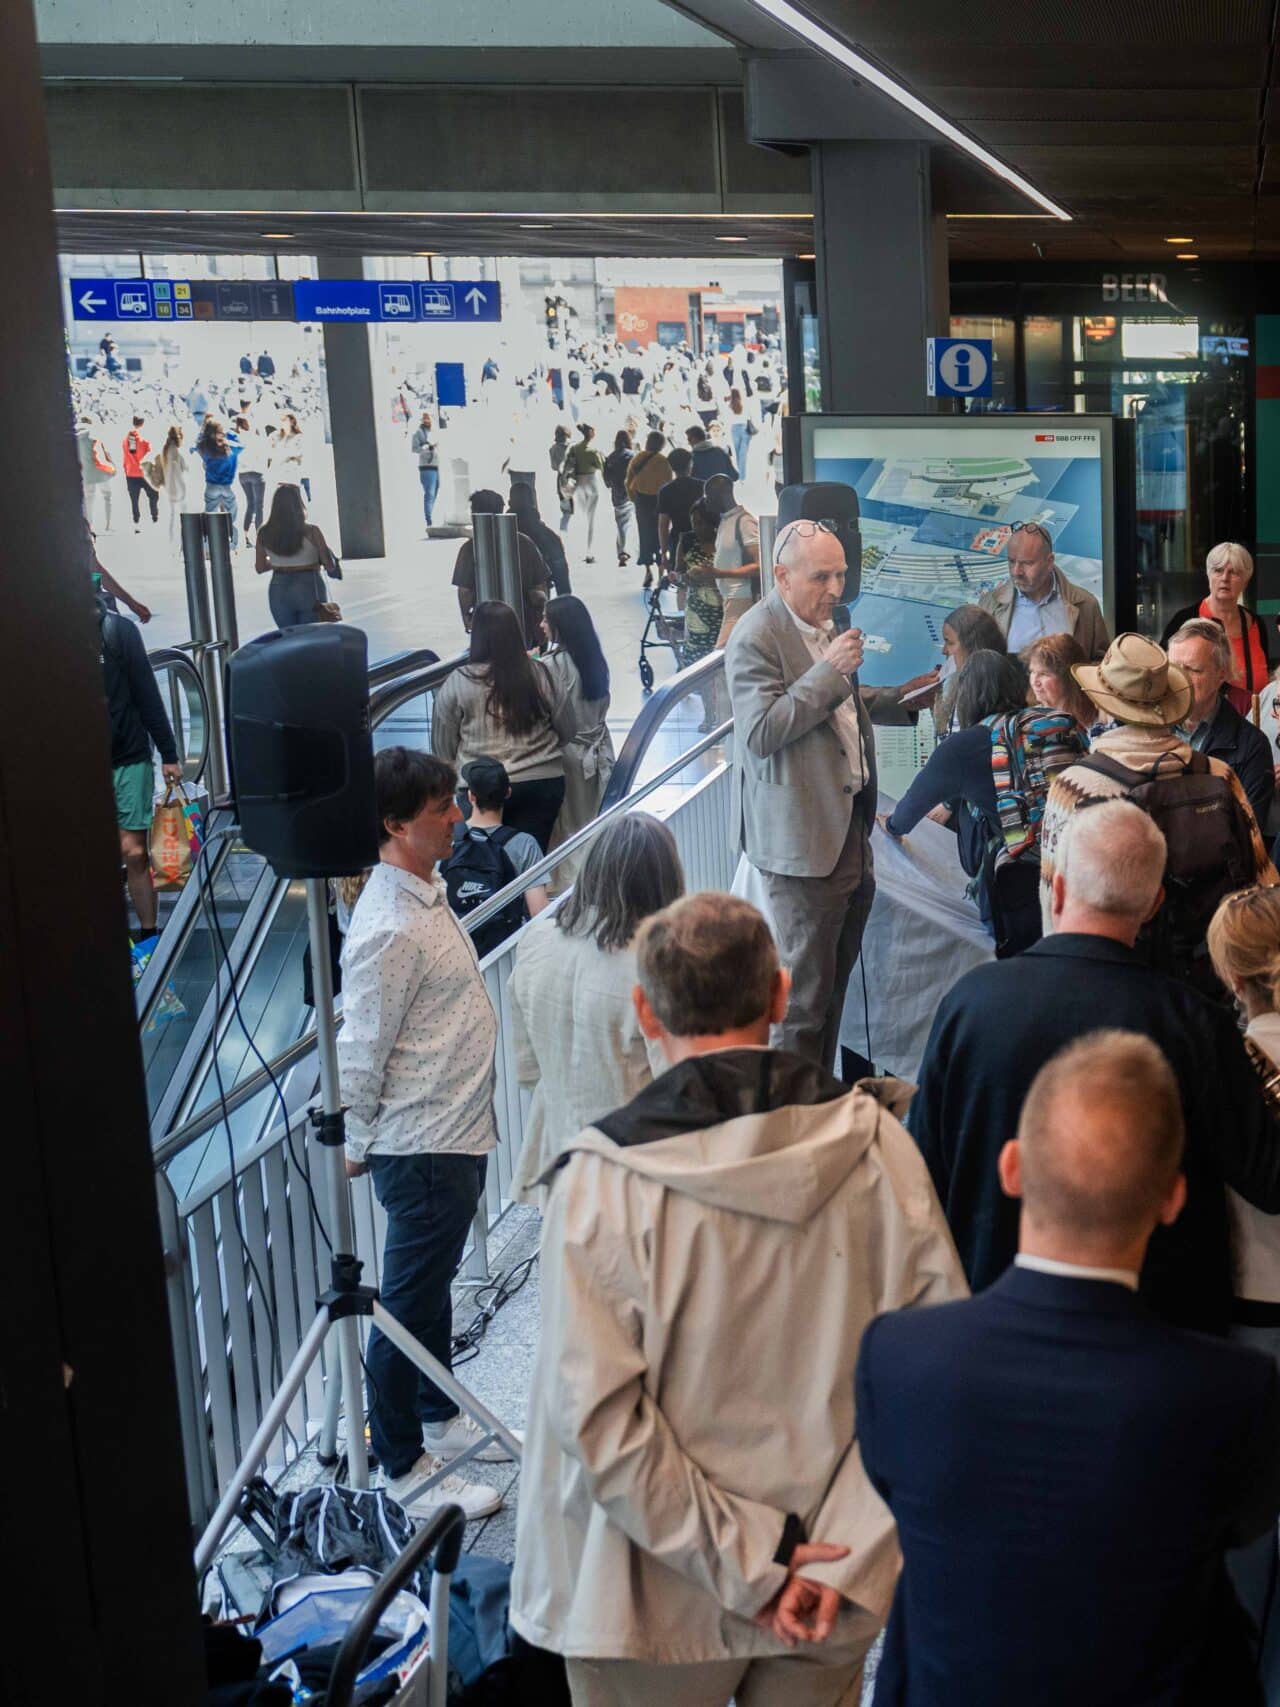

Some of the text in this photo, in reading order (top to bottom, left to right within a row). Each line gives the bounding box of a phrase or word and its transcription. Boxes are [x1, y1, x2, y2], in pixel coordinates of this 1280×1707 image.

[1102, 273, 1168, 303] BEER
[315, 306, 371, 316] Bahnhofplatz
[162, 818, 179, 882] MERCI
[462, 881, 485, 892] NIKE
